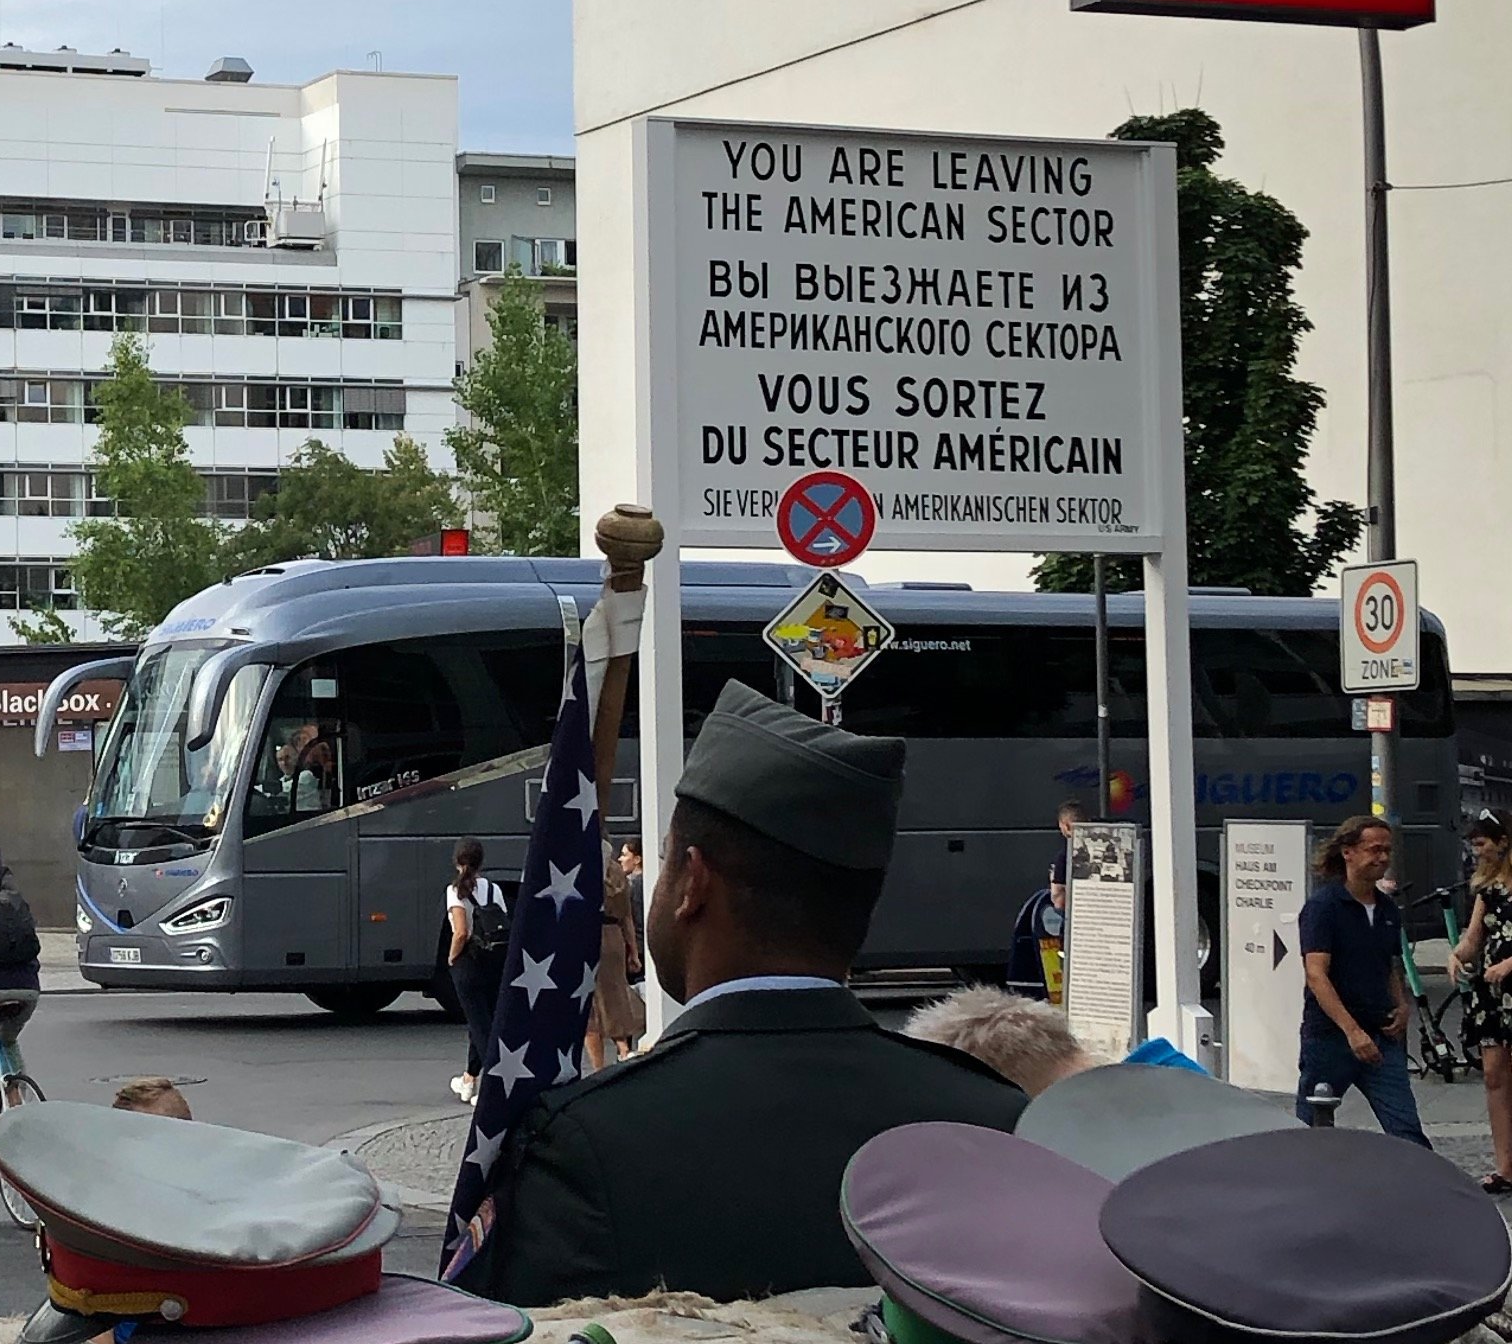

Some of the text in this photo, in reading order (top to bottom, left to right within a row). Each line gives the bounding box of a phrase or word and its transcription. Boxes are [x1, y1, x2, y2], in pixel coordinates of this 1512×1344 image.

[722, 140, 1092, 196] YOU ARE LEAVING
[701, 191, 1114, 248] THE AMERICAN SECTOR
[709, 260, 1110, 313] ВЫ ВЫЕЗЖАЕТЕ ИЗ
[698, 309, 1123, 361] АМЕРИКАНСКОГО СЕКТОРА
[757, 373, 1046, 420] VOUS SORTEZ
[702, 425, 1123, 475] DU SECTEUR AMÉRICAIN
[703, 488, 732, 517] SIE
[892, 494, 1049, 523] AMERIKANISCHEN
[1056, 497, 1123, 524] SEKTOR
[1365, 595, 1394, 632] 30
[1361, 659, 1399, 679] ZONE
[1235, 843, 1275, 855] MUSEUM
[1235, 861, 1277, 873] HAUS AM
[1235, 878, 1294, 892] CHECKPOINT
[1235, 896, 1274, 909] CHARLIE
